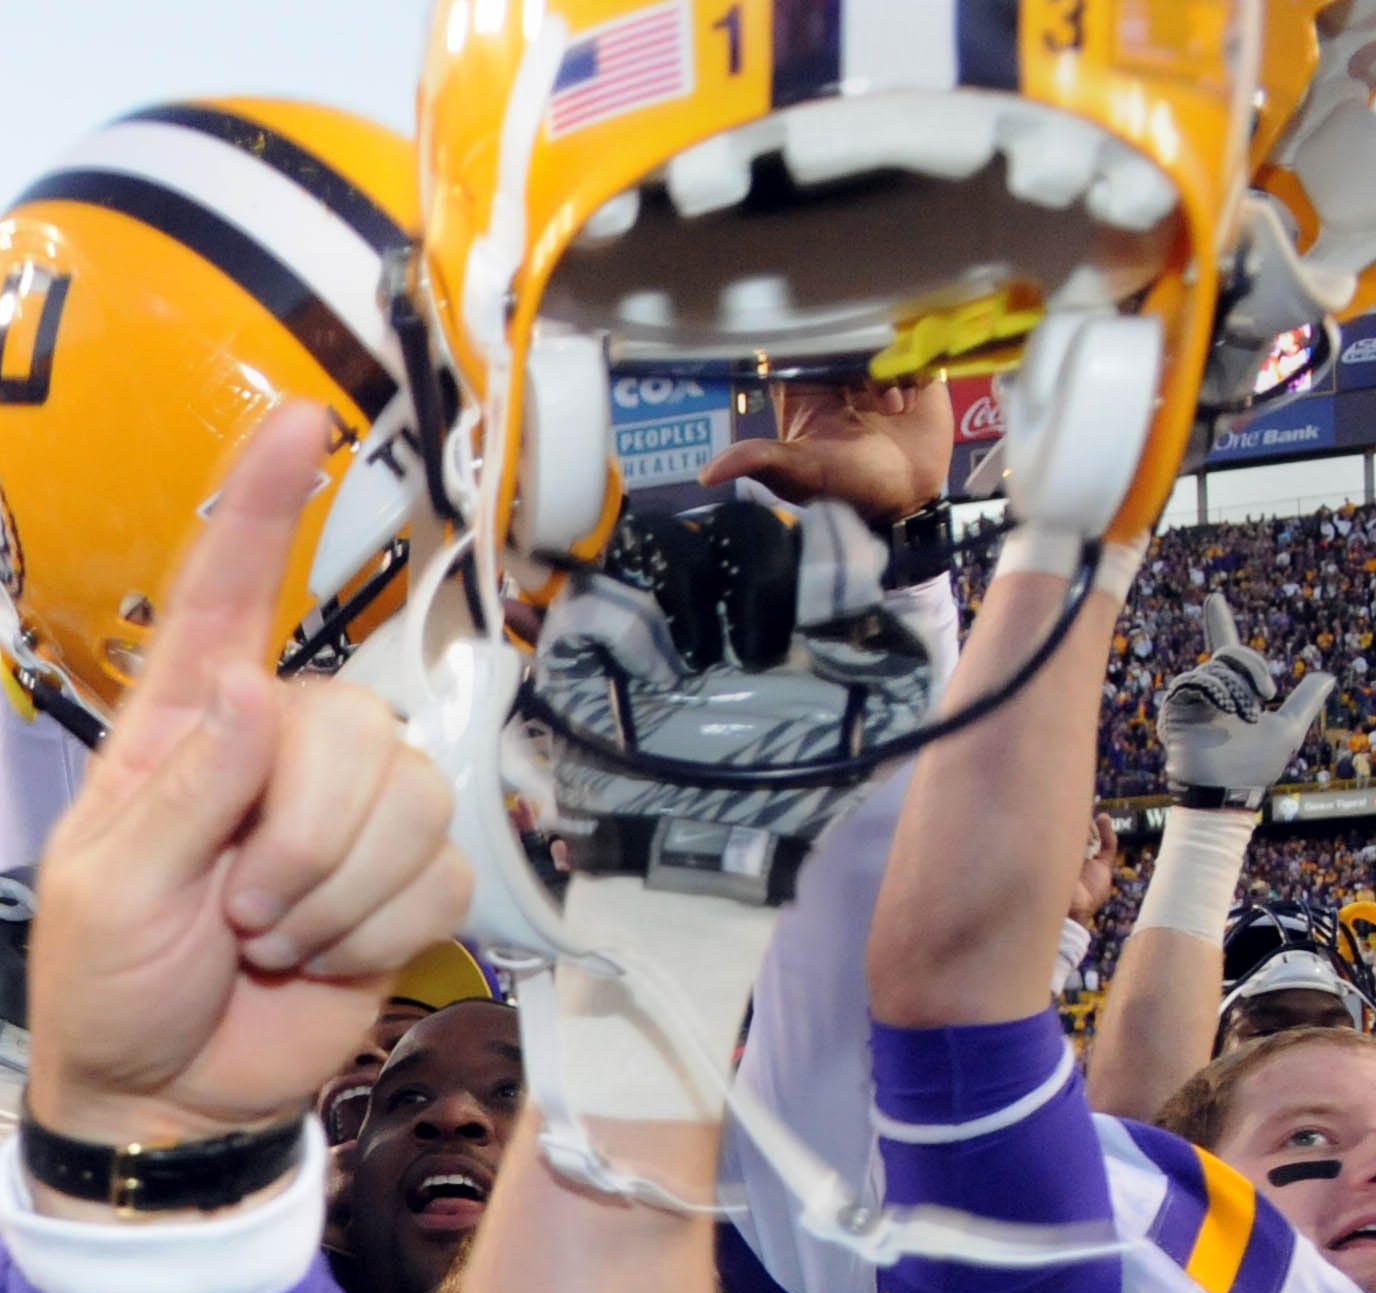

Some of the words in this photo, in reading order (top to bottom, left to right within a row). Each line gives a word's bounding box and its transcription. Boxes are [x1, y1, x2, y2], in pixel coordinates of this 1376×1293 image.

[711, 2, 743, 76] 1
[620, 421, 708, 451] PEOPLES
[1262, 423, 1319, 446] Bank
[624, 451, 708, 477] HEALTH
